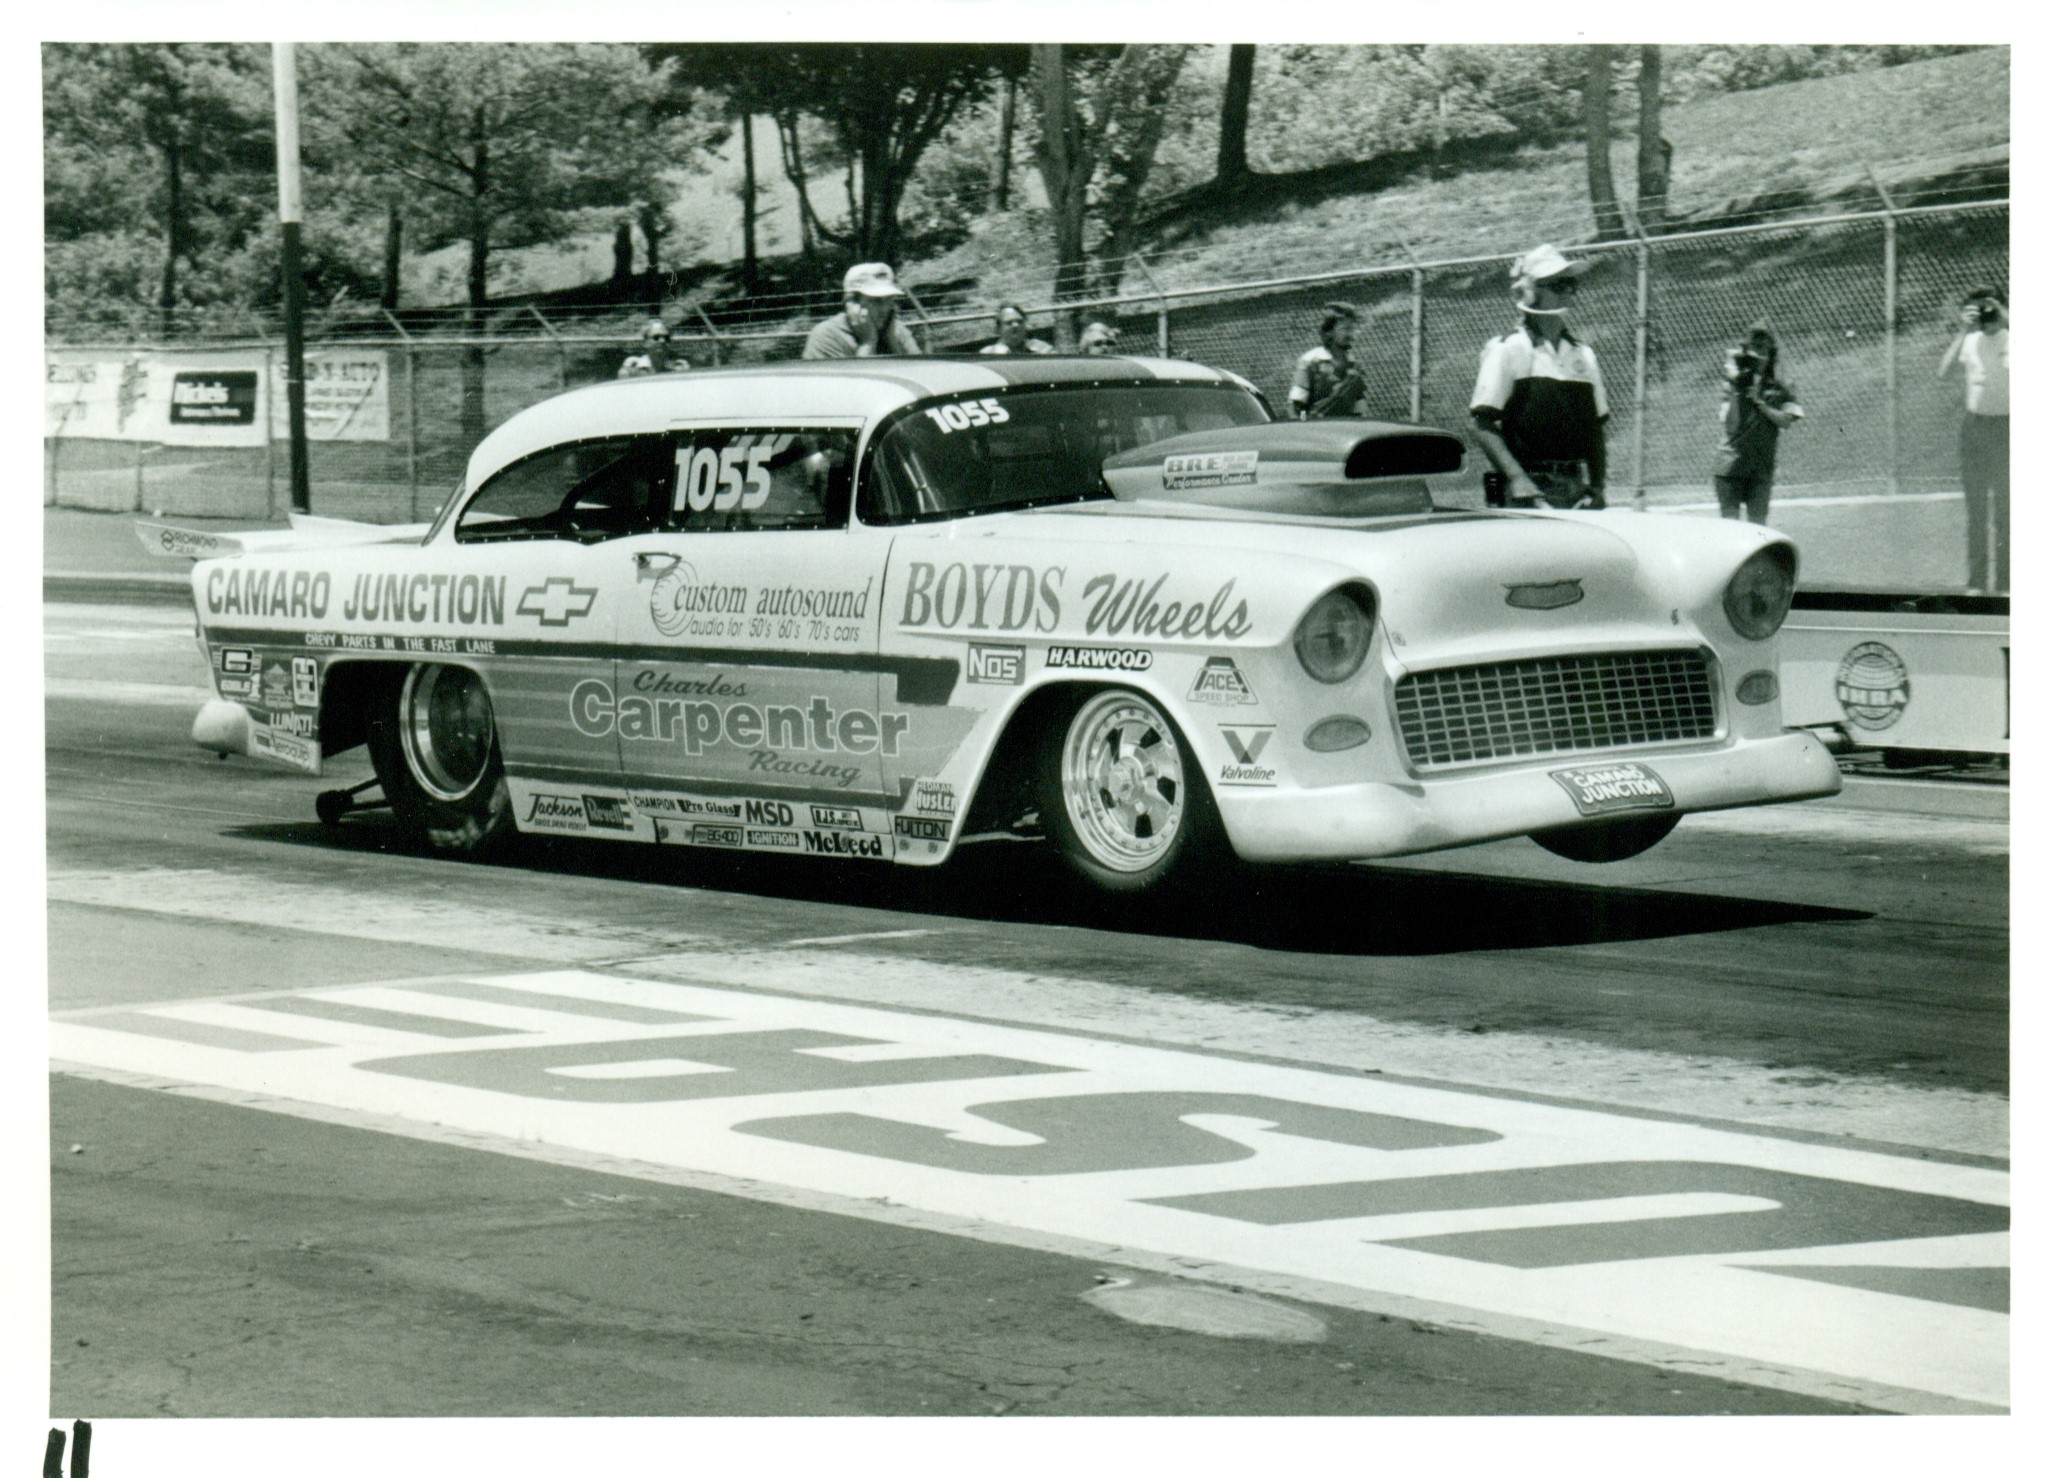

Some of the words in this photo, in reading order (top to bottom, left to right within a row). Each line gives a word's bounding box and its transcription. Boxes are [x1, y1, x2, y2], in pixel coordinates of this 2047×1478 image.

[925, 398, 1010, 434] 1055
[673, 445, 772, 512] 1055
[207, 568, 332, 619] CAMARO
[344, 573, 506, 625] JUNCTION
[674, 581, 747, 614] custom
[756, 576, 873, 618] autosound
[900, 561, 1067, 633] BOYDS
[1083, 572, 1253, 640] Wheels
[690, 616, 723, 636] audio
[727, 617, 744, 636] for
[834, 624, 860, 642] cars
[305, 632, 337, 648] CHEVY
[342, 634, 377, 649] PARTS
[383, 637, 396, 650] IN
[404, 637, 426, 651] THE
[432, 638, 458, 653] FAST
[466, 639, 496, 654] LANE
[968, 647, 1023, 679] NOS
[1047, 646, 1153, 670] HARWOOD
[634, 670, 748, 697] Charles
[1203, 673, 1239, 691] ACE
[1194, 692, 1222, 701] SPEED
[1225, 693, 1249, 702] SHOP
[269, 710, 313, 737] LUNATI
[570, 679, 909, 757] Carpenter
[749, 750, 861, 787] Racing
[1219, 764, 1276, 781] Valvoline
[1573, 768, 1645, 787] CAMARO
[634, 795, 676, 811] CHAMPION
[1582, 779, 1663, 804] JUNCTION
[523, 793, 584, 823] Jackson
[586, 797, 624, 824] Revell
[685, 800, 703, 812] Pro
[706, 801, 735, 815] Glass
[745, 800, 794, 826] MSD
[751, 832, 797, 846] IGNITION
[803, 831, 883, 857] McLeod
